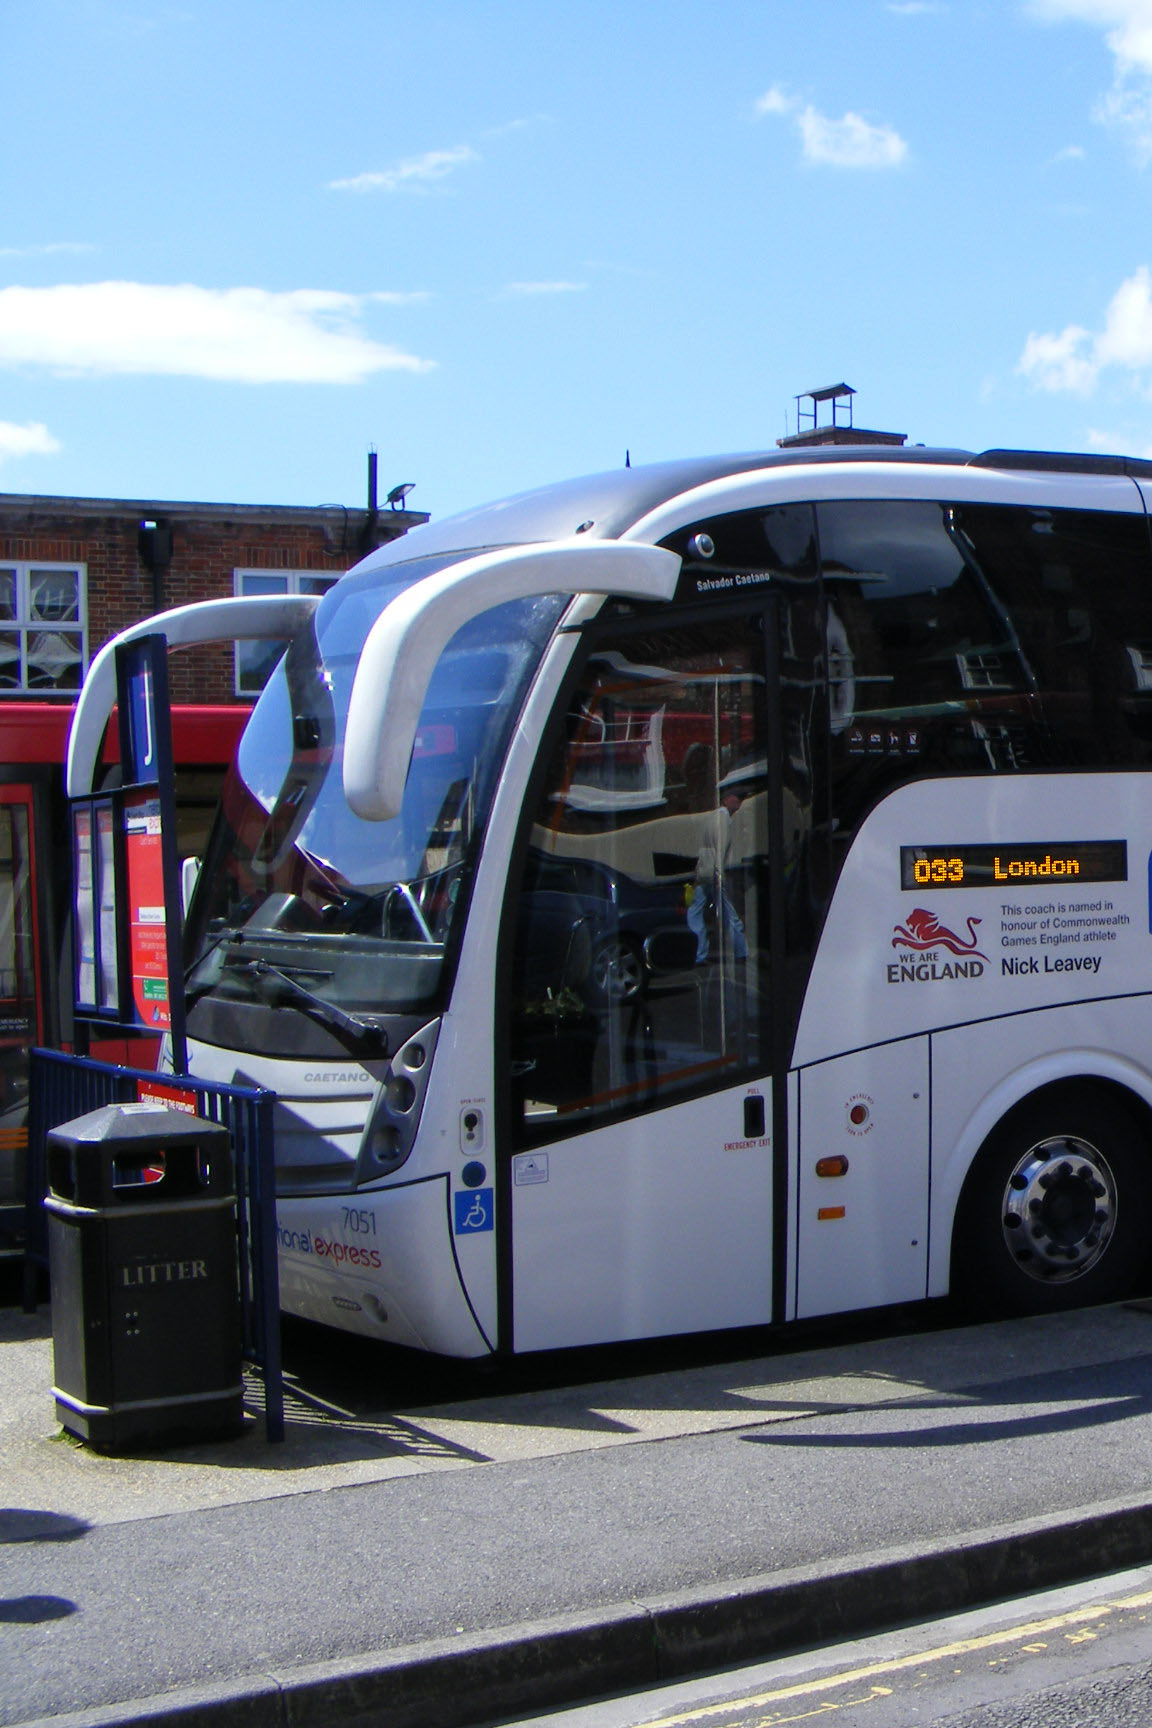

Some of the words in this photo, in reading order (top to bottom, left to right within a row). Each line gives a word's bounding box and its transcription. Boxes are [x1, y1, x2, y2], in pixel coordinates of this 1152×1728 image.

[697, 577, 734, 592] Salvador
[735, 572, 770, 586] Caetano
[913, 858, 964, 883] 033
[994, 855, 1081, 880] London
[1001, 905, 1022, 916] This
[1025, 904, 1055, 915] coach
[1058, 903, 1066, 913] is
[1068, 901, 1102, 913] named
[1104, 900, 1113, 911] in
[1001, 920, 1038, 932] honour
[1040, 918, 1050, 929] of
[1053, 914, 1130, 929] Commonwealth
[1001, 935, 1037, 947] Games
[1040, 932, 1081, 947] England
[1083, 930, 1117, 942] athlete
[900, 954, 917, 964] WE
[919, 952, 939, 963] ARE
[1001, 956, 1039, 976] Nick
[1044, 955, 1102, 974] Leavey
[887, 961, 984, 984] ENGLAND
[304, 1073, 369, 1082] CAETANO
[724, 1140, 756, 1151] EMERGENCY
[759, 1138, 770, 1147] EXIT
[341, 1206, 376, 1235] 7051
[314, 1237, 382, 1269] express
[124, 1260, 208, 1286] LITTER
